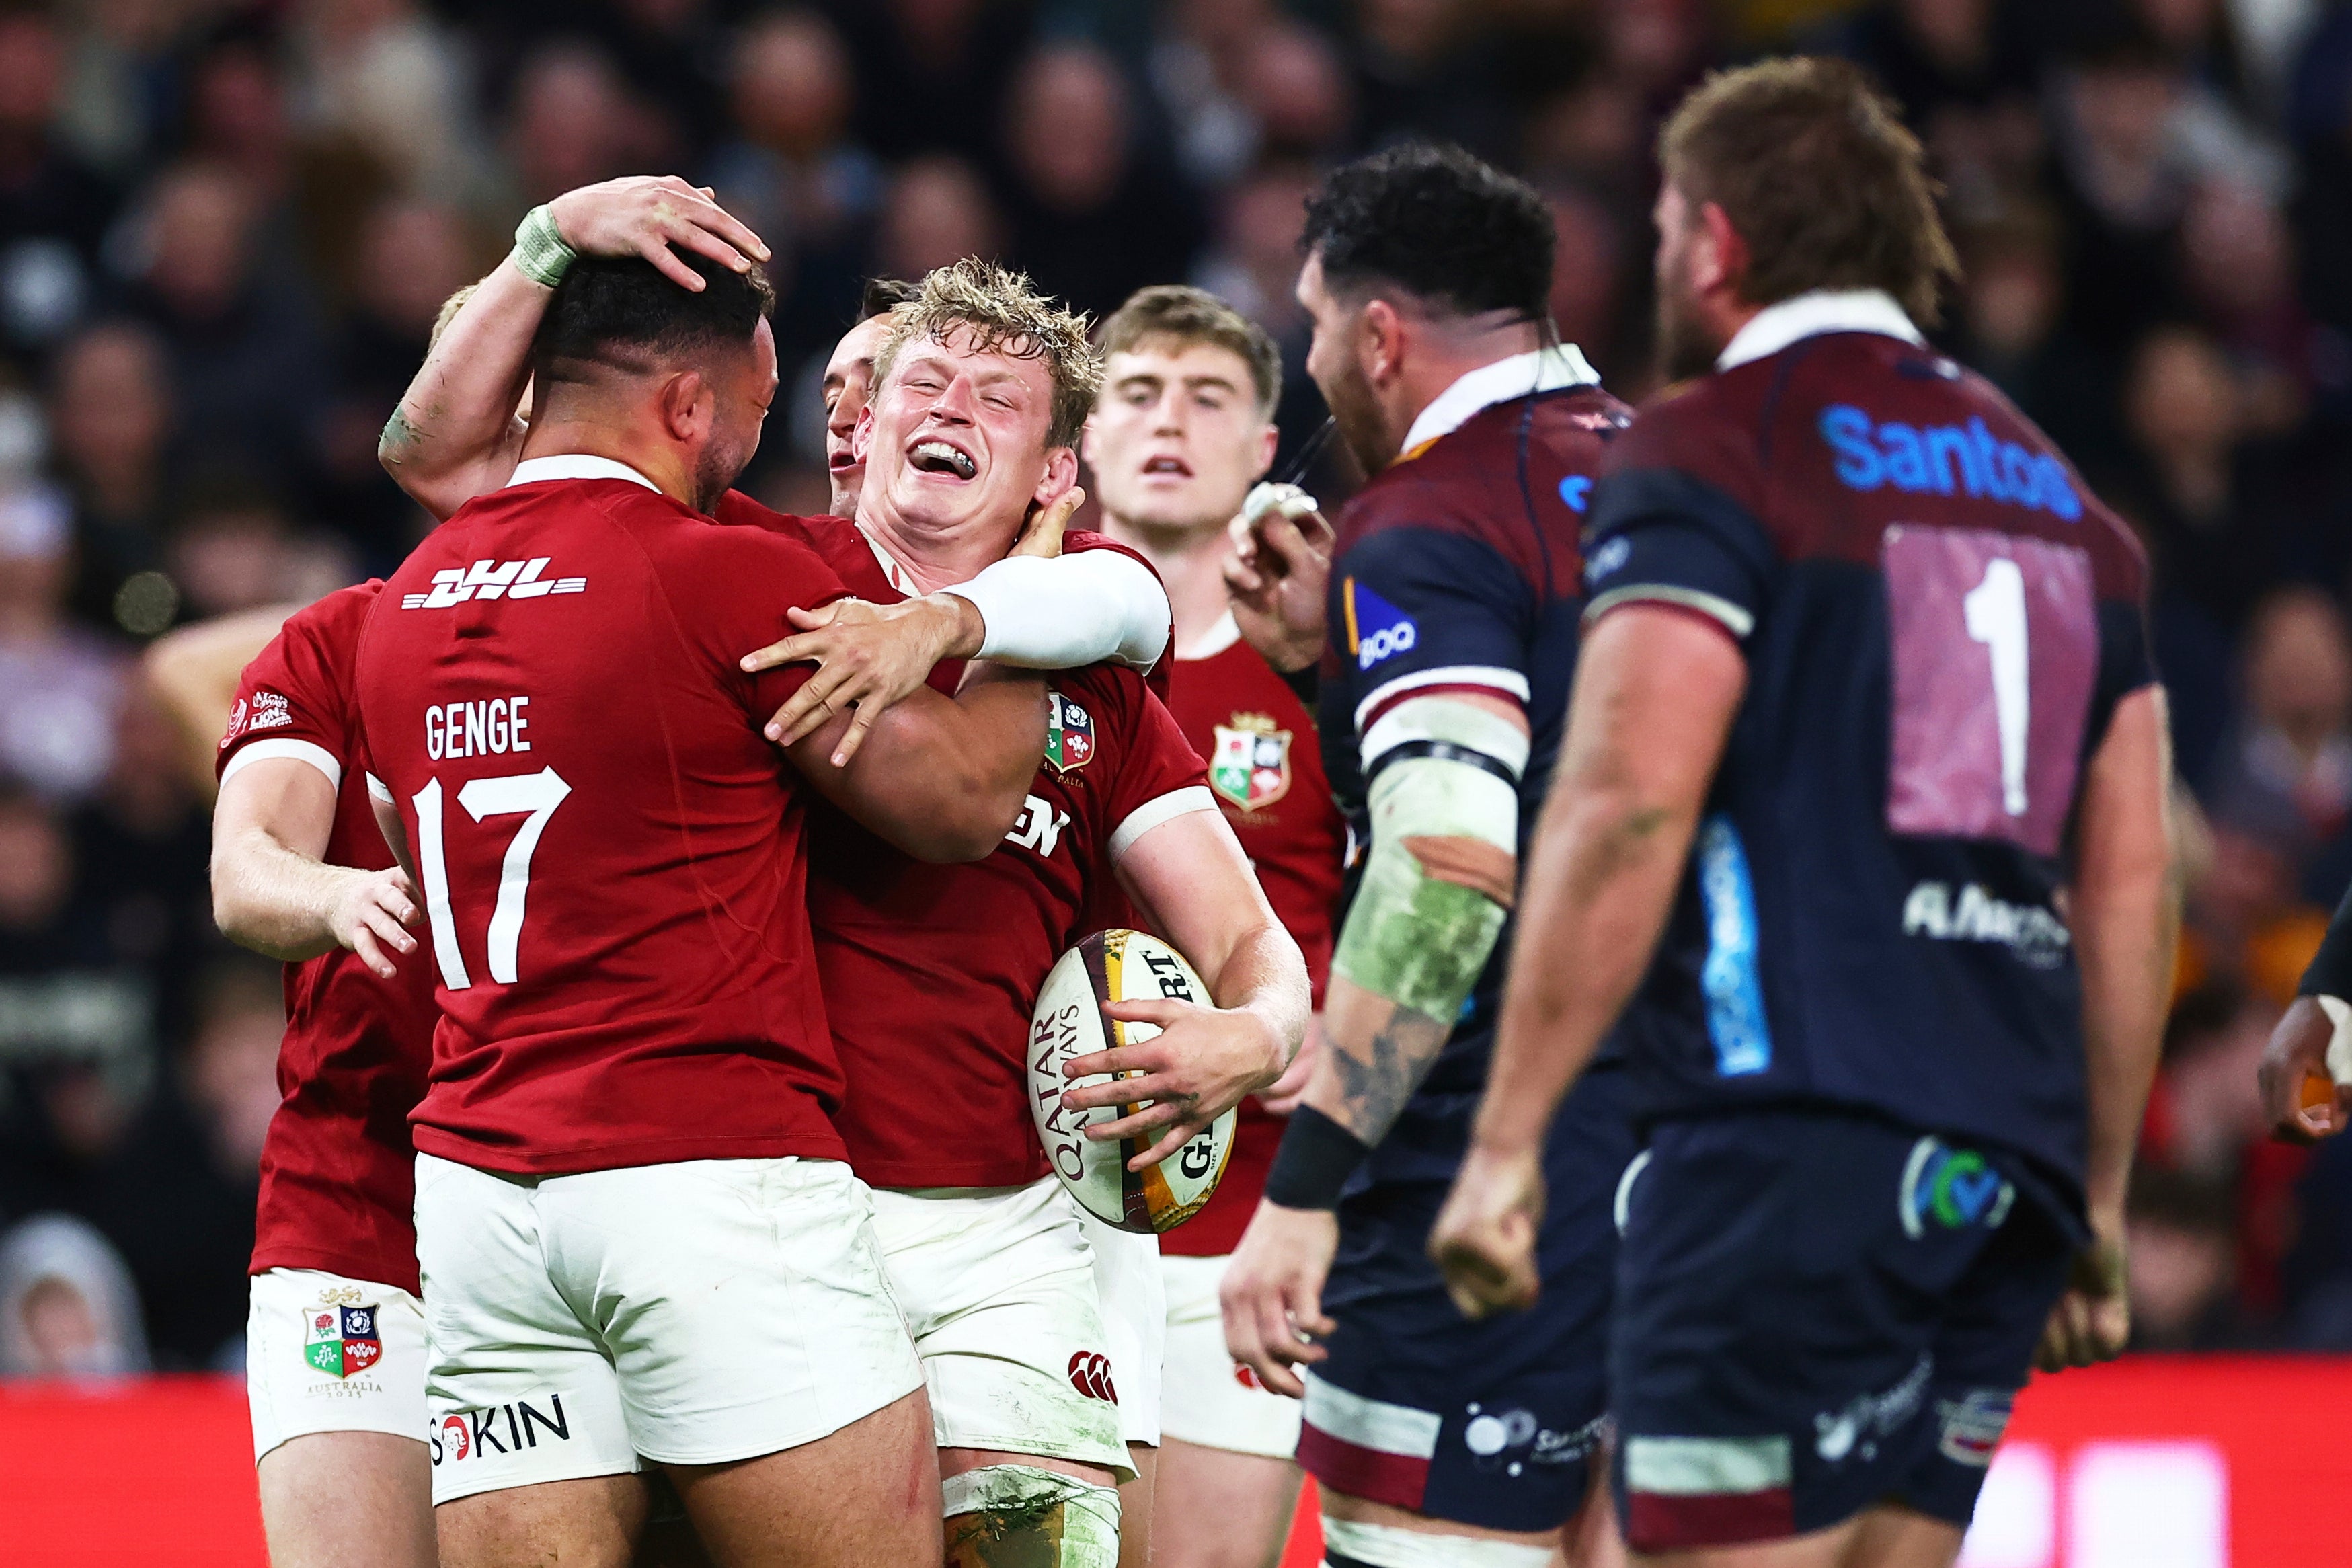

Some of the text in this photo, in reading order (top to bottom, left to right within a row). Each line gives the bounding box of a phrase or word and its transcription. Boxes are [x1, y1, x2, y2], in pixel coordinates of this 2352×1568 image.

[1819, 404, 2082, 522] Santos
[420, 557, 558, 609] DHL
[426, 696, 531, 760] GENGE
[1964, 558, 2029, 817] 1
[412, 765, 572, 990] 17
[1034, 1011, 1085, 1181] QATAR
[307, 1381, 382, 1393] AUSTRALIA
